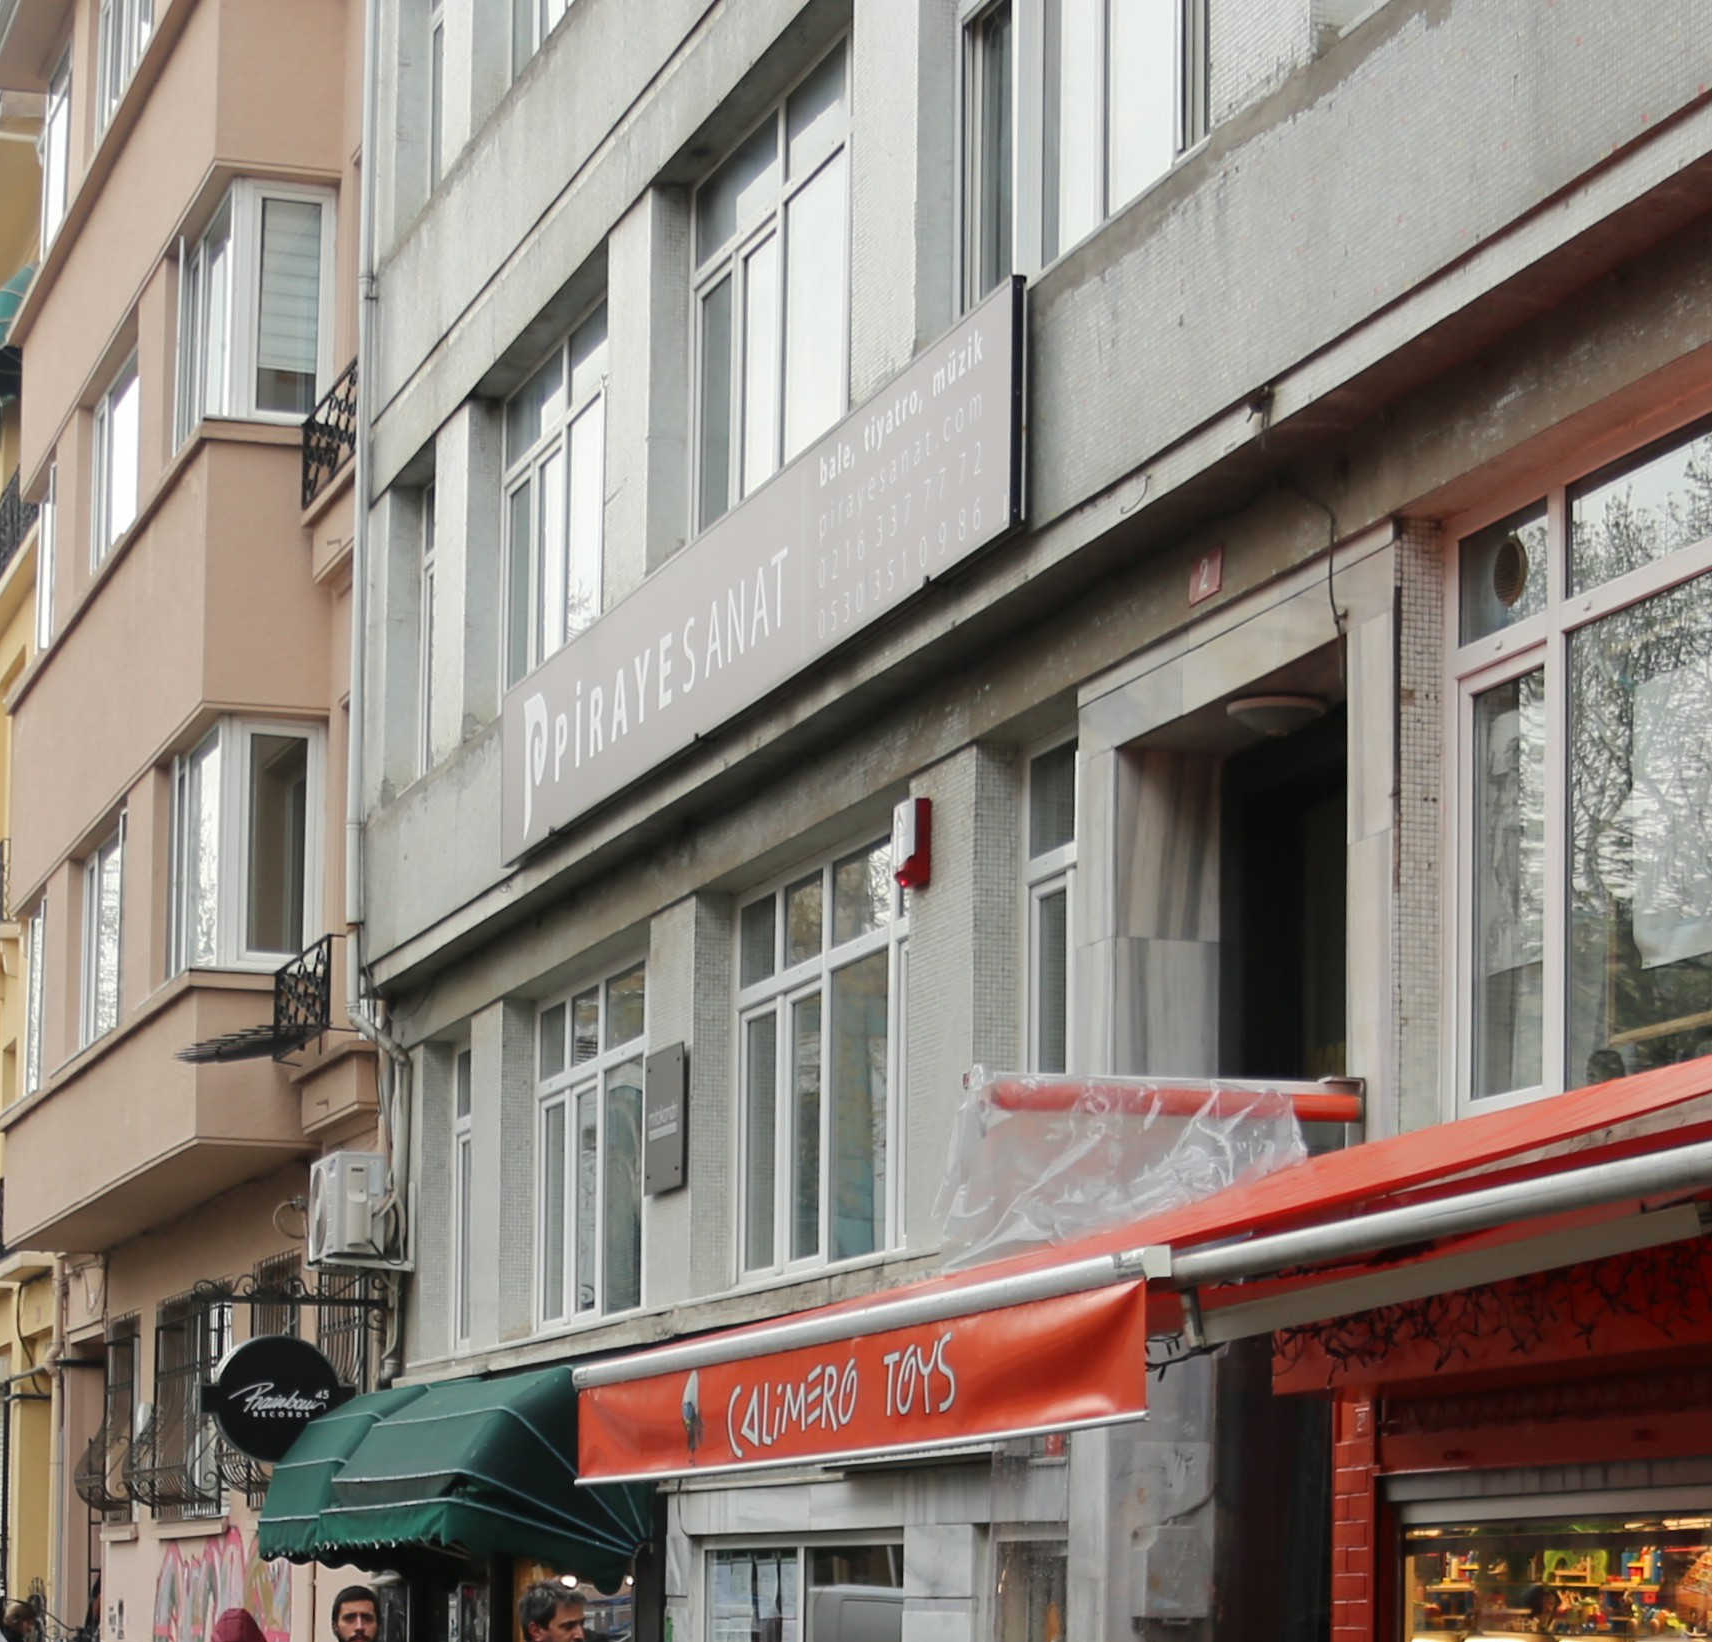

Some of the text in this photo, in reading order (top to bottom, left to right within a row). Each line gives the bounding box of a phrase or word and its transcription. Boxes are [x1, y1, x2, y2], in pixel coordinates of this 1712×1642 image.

[819, 330, 983, 488] bale, tiyatro, müzik
[818, 392, 983, 545] pirayesanat.com
[252, 1410, 311, 1419] RECORDS
[315, 1389, 330, 1400] 45
[883, 1331, 957, 1417] TOYS
